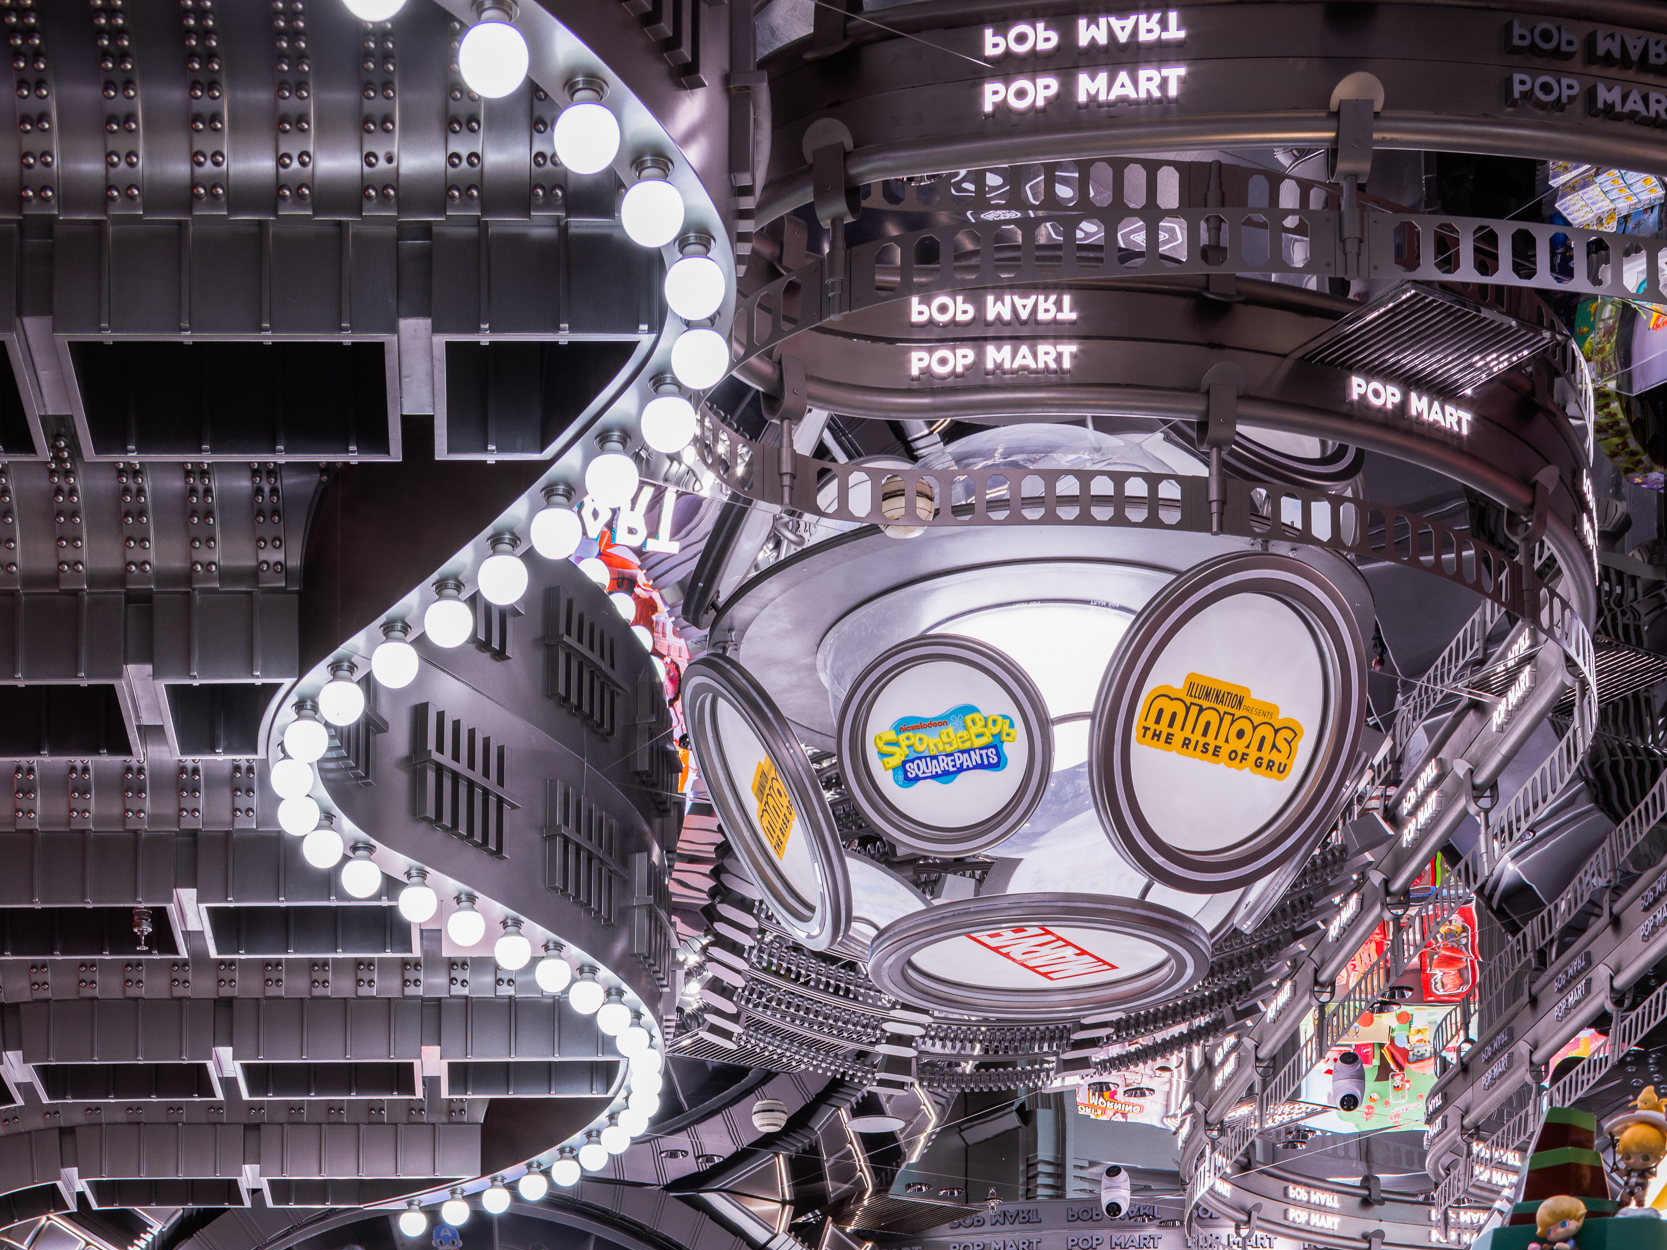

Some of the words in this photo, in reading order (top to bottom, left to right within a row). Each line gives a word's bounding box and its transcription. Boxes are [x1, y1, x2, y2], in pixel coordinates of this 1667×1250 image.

[984, 76, 1059, 113] POP
[1078, 66, 1186, 102] MART
[1512, 73, 1580, 104] POP
[1596, 82, 1667, 117] MAR
[911, 349, 975, 376] POP
[986, 345, 1077, 369] MART
[1352, 376, 1401, 409] POP
[1410, 391, 1472, 435] MART
[1186, 681, 1245, 711] ILLUMINATION
[1241, 704, 1274, 720] PRESENTS
[1492, 697, 1507, 732] POP
[1508, 664, 1530, 711] MART
[899, 720, 948, 732] nickelodeon
[905, 748, 998, 778] SQUAREPANTS
[1141, 725, 1175, 746] THE
[1181, 736, 1223, 758] RISE
[1228, 749, 1250, 764] OF
[1254, 756, 1288, 774] GRU
[1402, 817, 1417, 848] POP
[1417, 790, 1438, 829] MART
[973, 927, 1114, 980] MARVE
[1554, 999, 1566, 1021] POP
[1568, 979, 1586, 1008] MART
[1288, 1208, 1309, 1224] POP
[1310, 1212, 1340, 1230] MART
[1067, 1235, 1104, 1250] POP
[1111, 1234, 1162, 1249] MART
